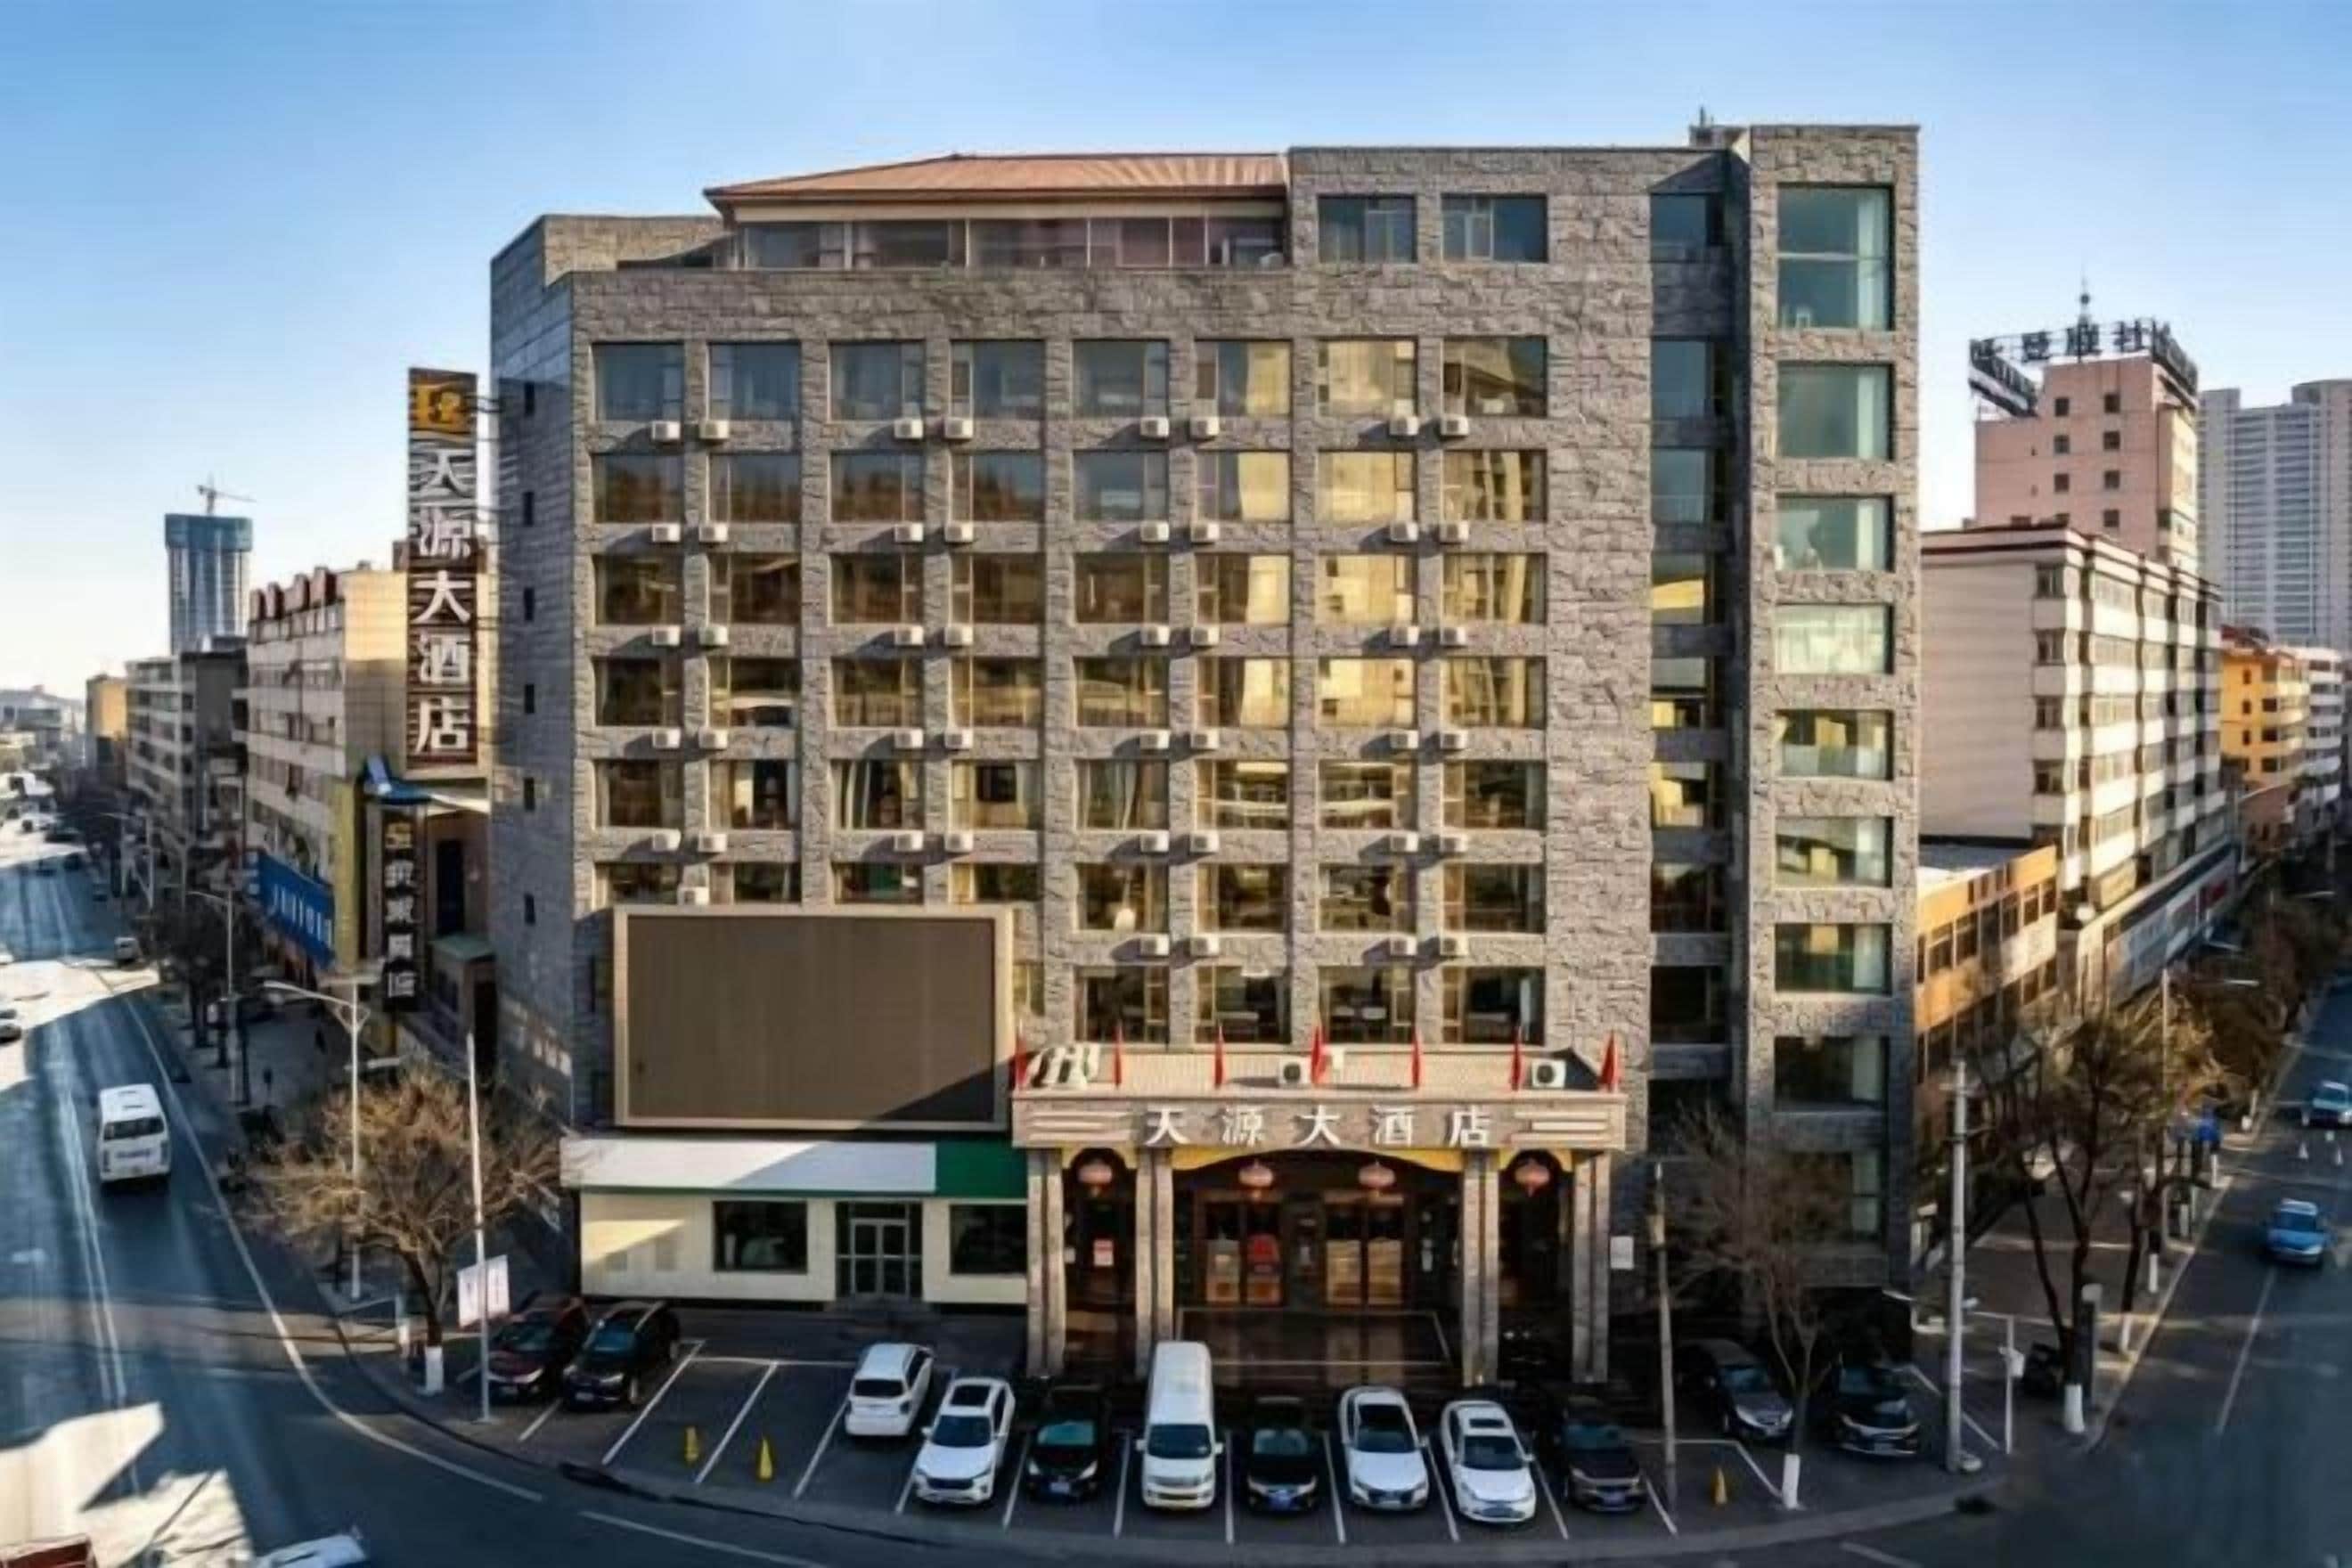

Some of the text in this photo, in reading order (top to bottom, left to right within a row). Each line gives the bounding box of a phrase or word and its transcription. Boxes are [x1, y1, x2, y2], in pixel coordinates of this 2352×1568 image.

[411, 447, 473, 754] 天源大酒店
[1144, 1106, 1493, 1146] 天源大酒店
